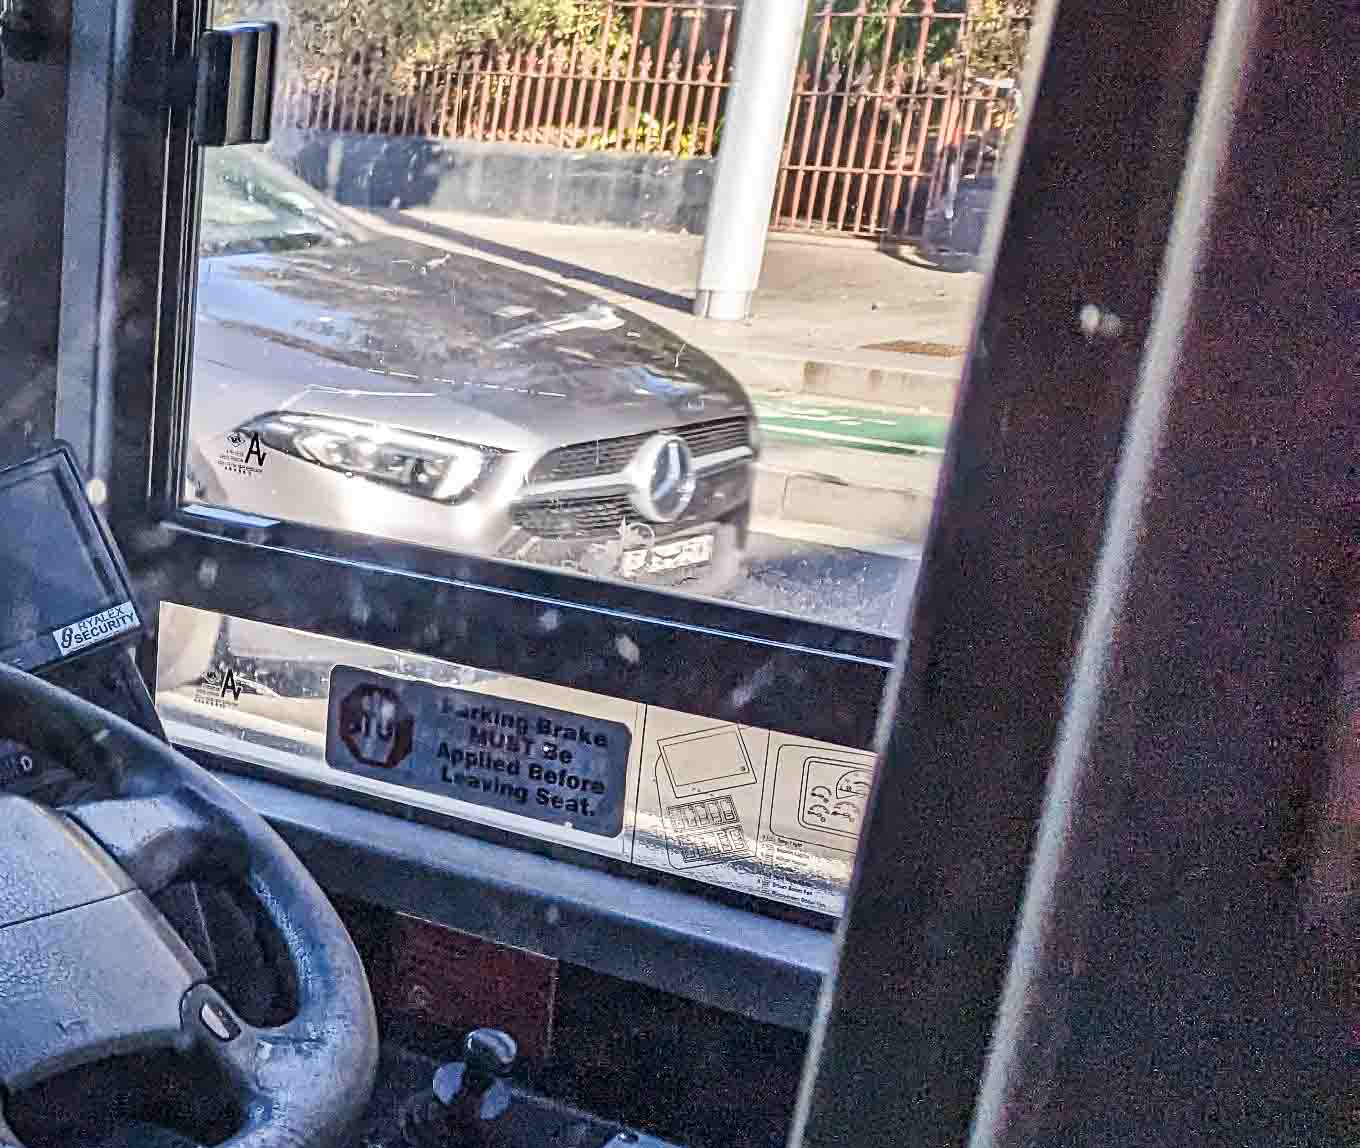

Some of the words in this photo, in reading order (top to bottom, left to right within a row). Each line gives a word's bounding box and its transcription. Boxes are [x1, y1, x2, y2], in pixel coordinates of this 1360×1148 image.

[75, 612, 134, 643] SECURITY
[79, 607, 123, 631] RYALEX
[440, 697, 528, 735] Parking
[535, 716, 608, 747] Brake
[470, 725, 534, 754] MUST
[543, 741, 572, 763] Be
[437, 741, 520, 775] Applied
[529, 762, 605, 795] Before
[441, 765, 528, 804] Leaving
[535, 786, 594, 817] Seat.
